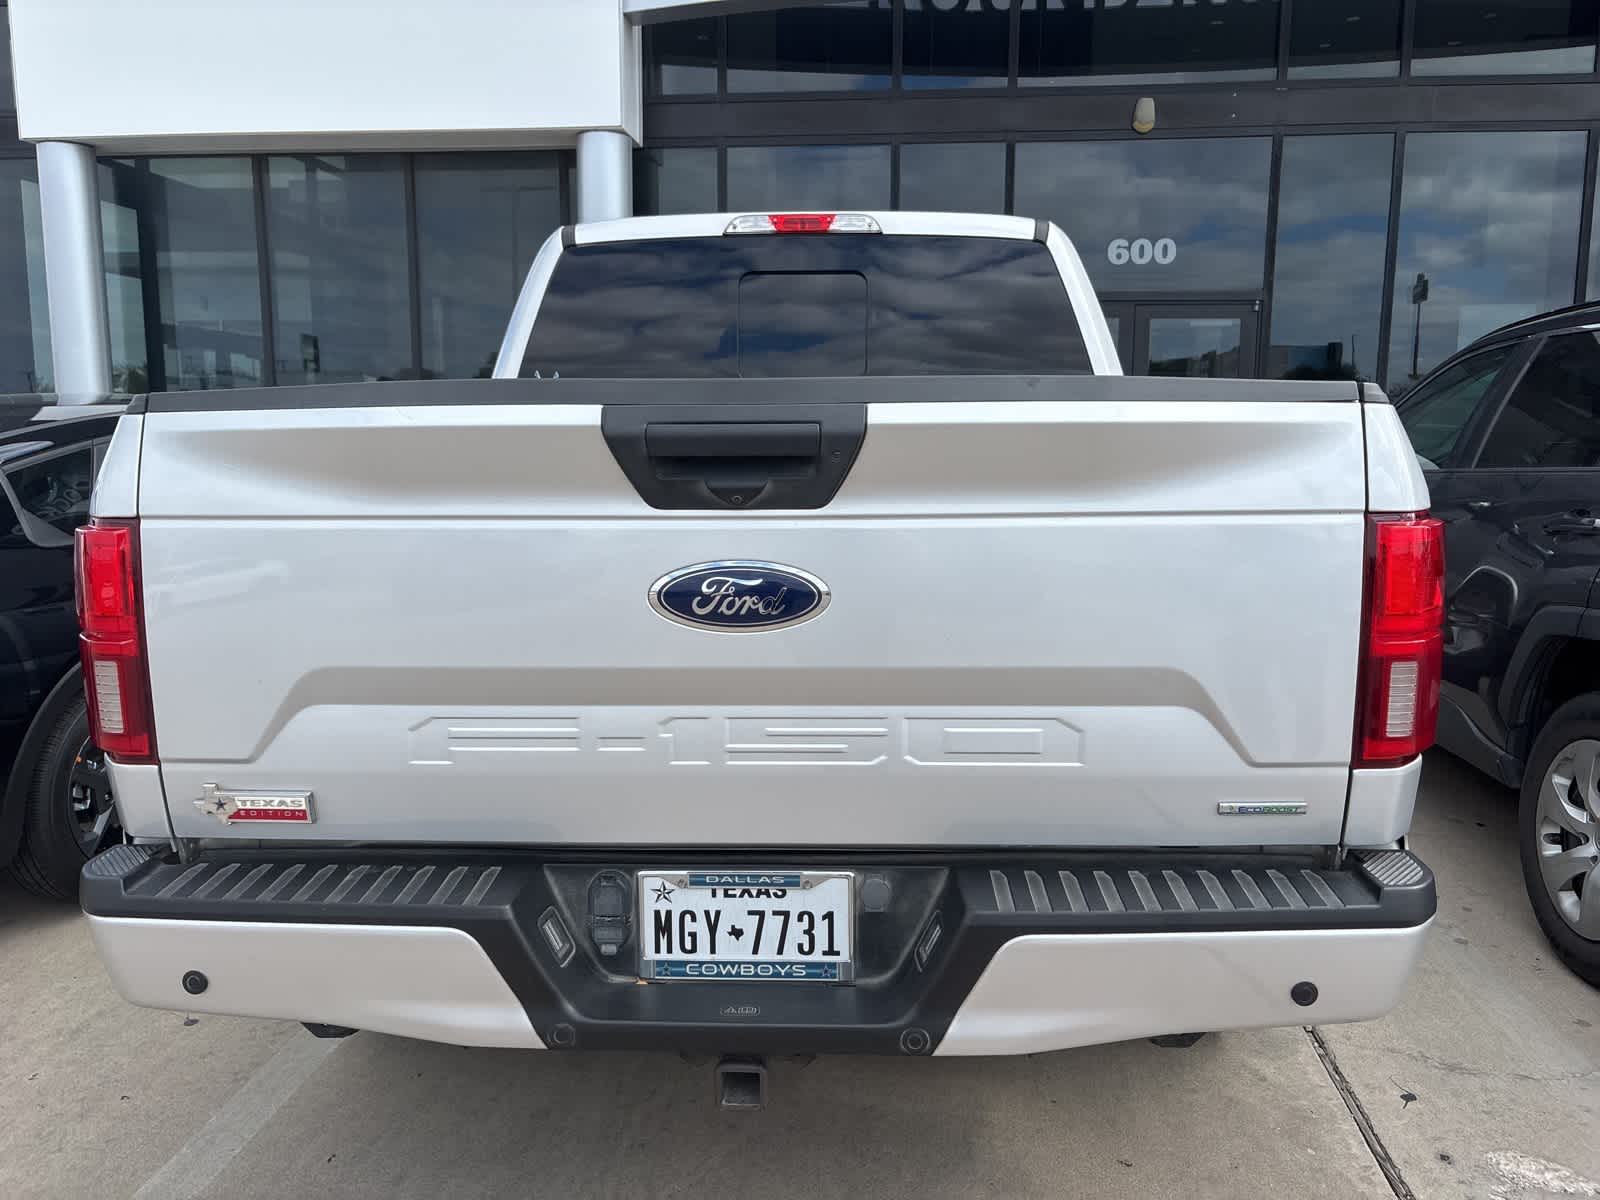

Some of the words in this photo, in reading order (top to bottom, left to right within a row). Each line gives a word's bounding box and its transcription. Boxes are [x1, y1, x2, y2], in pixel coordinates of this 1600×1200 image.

[1107, 238, 1177, 265] 600
[691, 576, 788, 615] Ford
[408, 716, 1083, 768] F-150
[237, 799, 303, 808] TEXAS
[705, 875, 785, 884] DALLAS
[653, 909, 721, 955] MGY
[747, 910, 841, 957] 7731
[685, 963, 807, 976] COWBOYS
